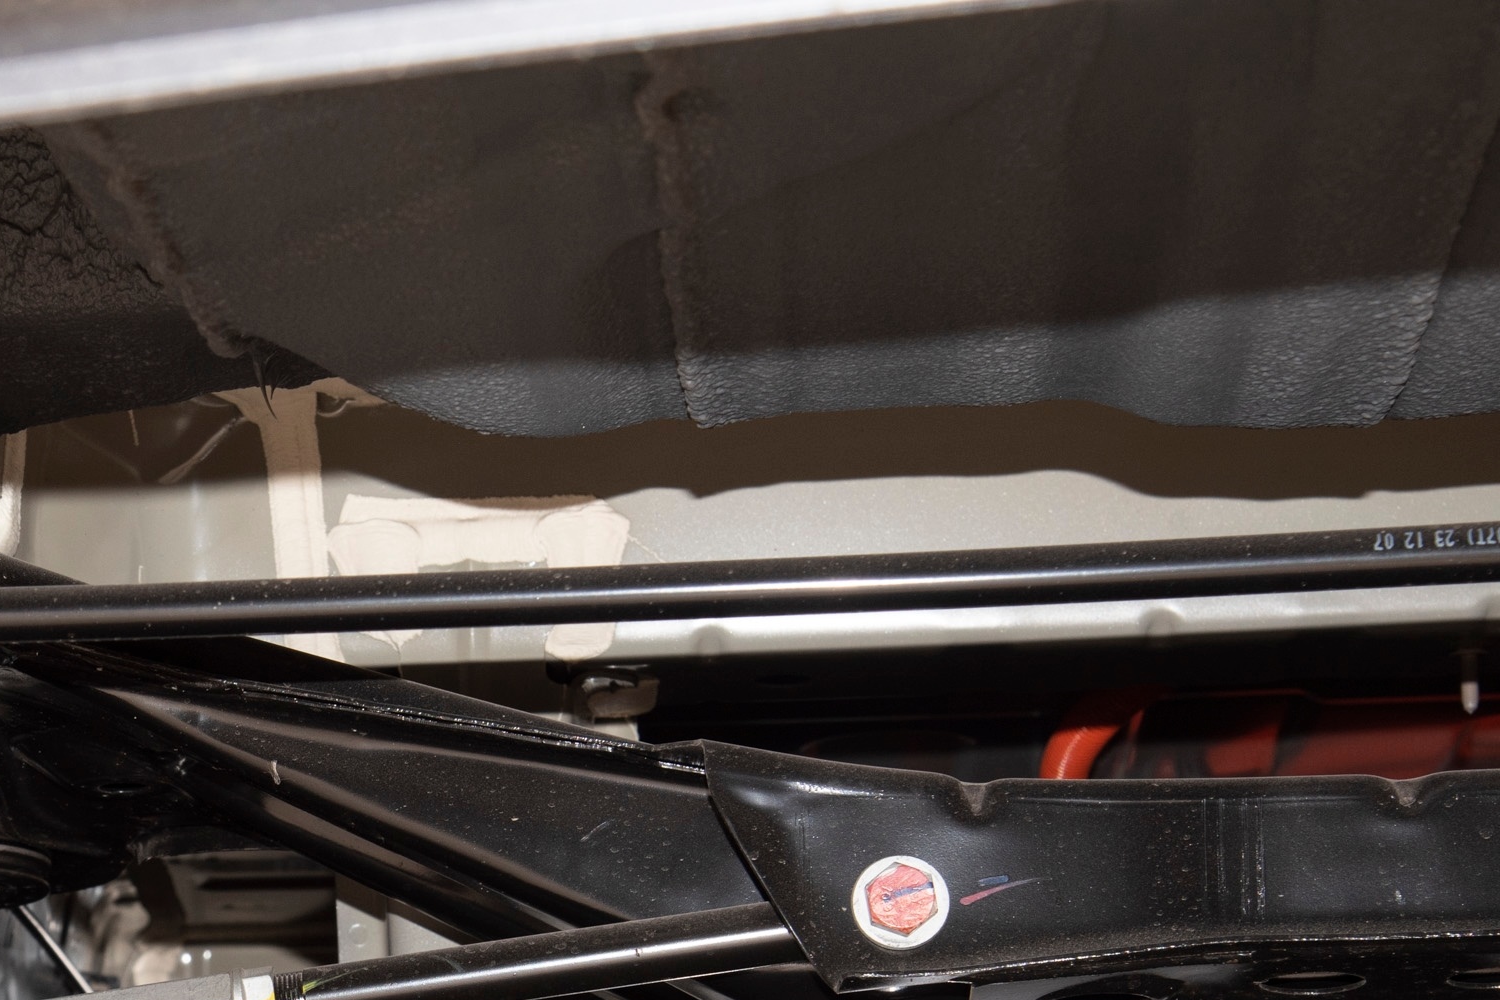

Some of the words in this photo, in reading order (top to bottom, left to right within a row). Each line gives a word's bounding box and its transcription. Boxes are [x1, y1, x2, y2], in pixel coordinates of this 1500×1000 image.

[1373, 532, 1395, 551] 07
[1404, 530, 1423, 550] 12
[1434, 528, 1455, 548] 23
